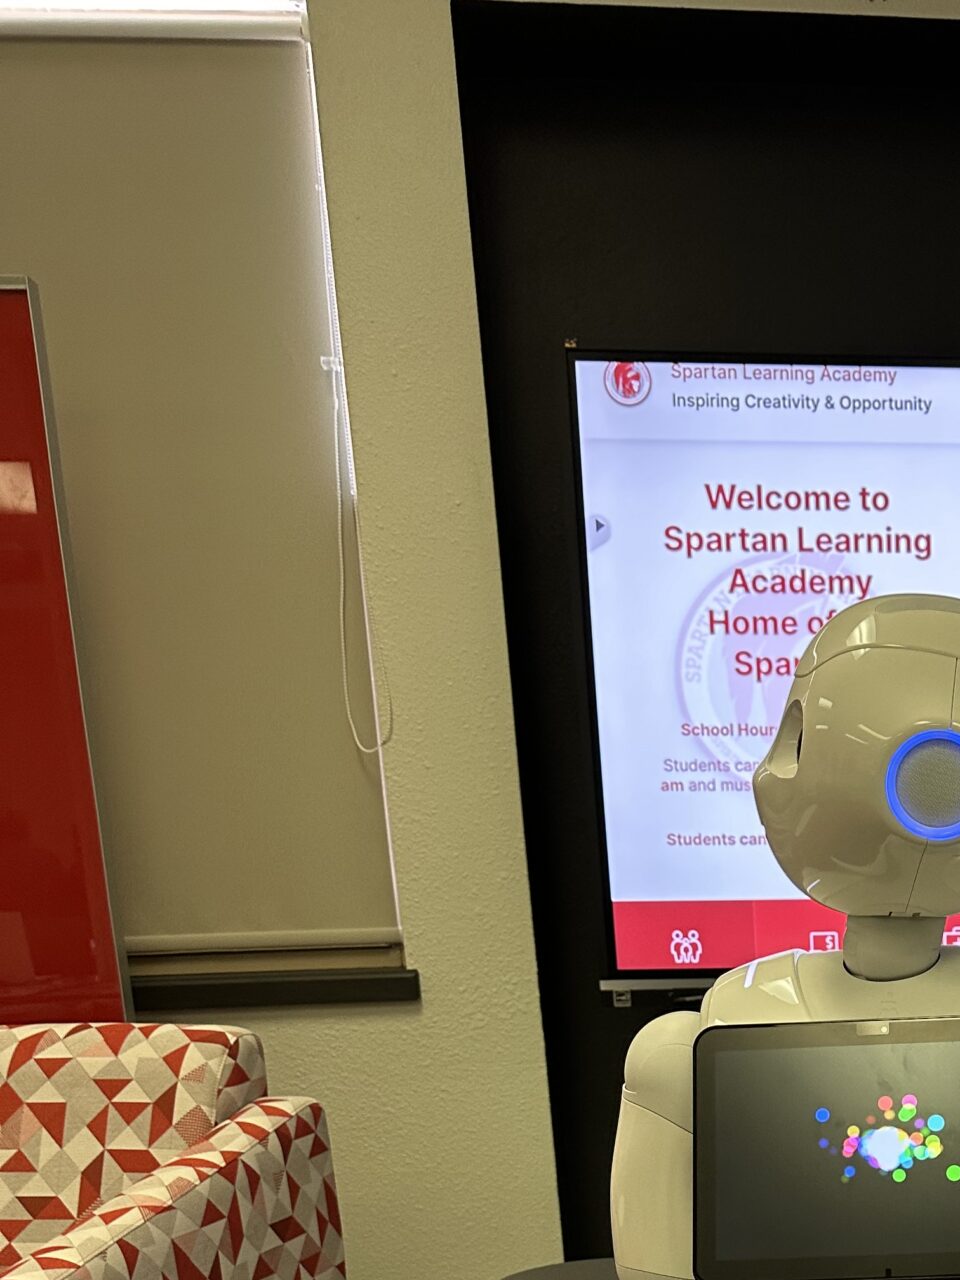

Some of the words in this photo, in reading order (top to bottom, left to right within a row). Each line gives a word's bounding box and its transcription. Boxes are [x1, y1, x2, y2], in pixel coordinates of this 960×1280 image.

[671, 363, 738, 383] Spartan
[742, 365, 816, 385] Learning
[820, 366, 897, 386] Academy
[672, 393, 741, 412] Inspiring
[745, 394, 820, 413] Creativity
[824, 395, 835, 410] &
[840, 396, 932, 415] Opportunity
[705, 483, 850, 511] Welcome
[859, 486, 889, 511] to
[664, 526, 787, 558] Spartan
[798, 527, 932, 559] Learning
[729, 568, 872, 600] Academy
[709, 609, 797, 636] Home
[681, 724, 734, 736] School
[664, 759, 730, 772] Students
[661, 782, 683, 792] am
[689, 779, 716, 792] and
[667, 833, 735, 846] Students
